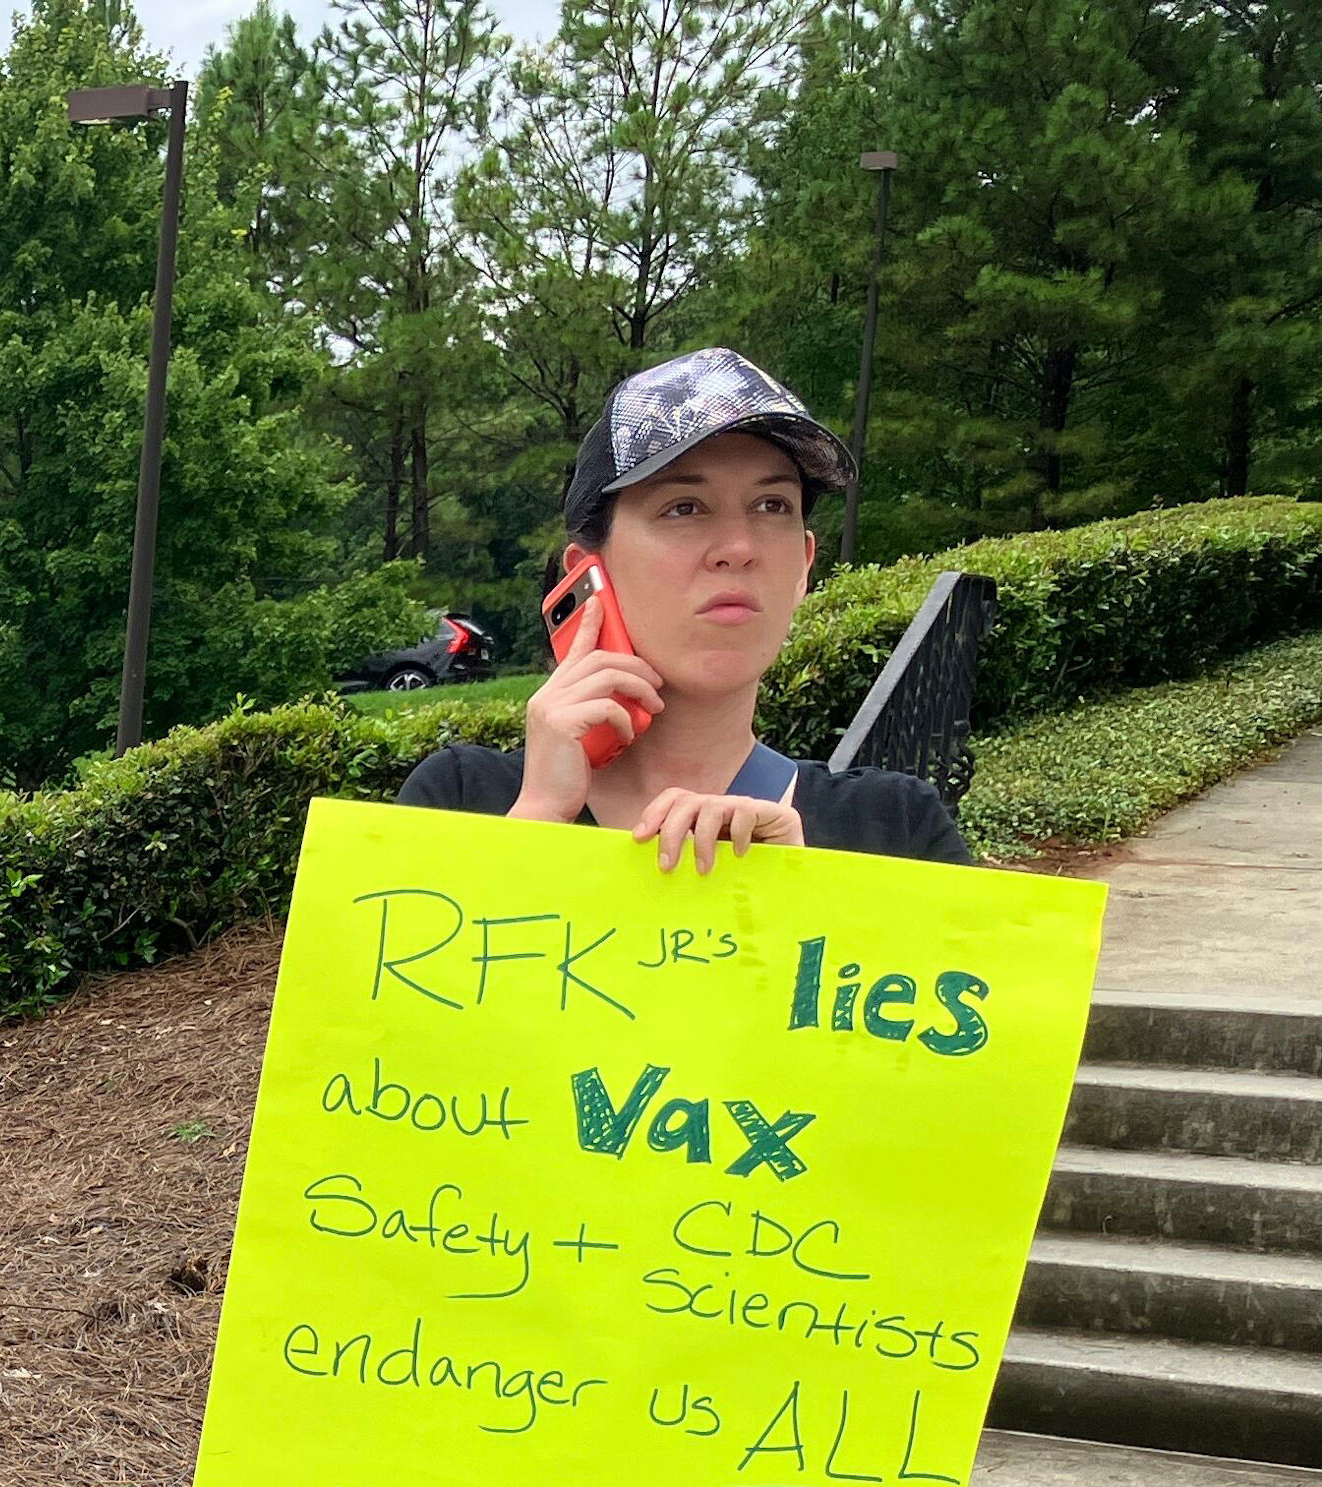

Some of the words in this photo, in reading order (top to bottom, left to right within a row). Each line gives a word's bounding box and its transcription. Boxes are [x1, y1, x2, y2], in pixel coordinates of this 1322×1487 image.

[354, 890, 635, 1020] RFK
[638, 928, 737, 967] JR's
[787, 936, 989, 1056] lies
[323, 1058, 529, 1139] about
[571, 1064, 816, 1182] Vax
[304, 1175, 529, 1298] Safety
[673, 1201, 870, 1280] CDC
[284, 1318, 607, 1433] endanger
[737, 1381, 957, 1485] ALL
